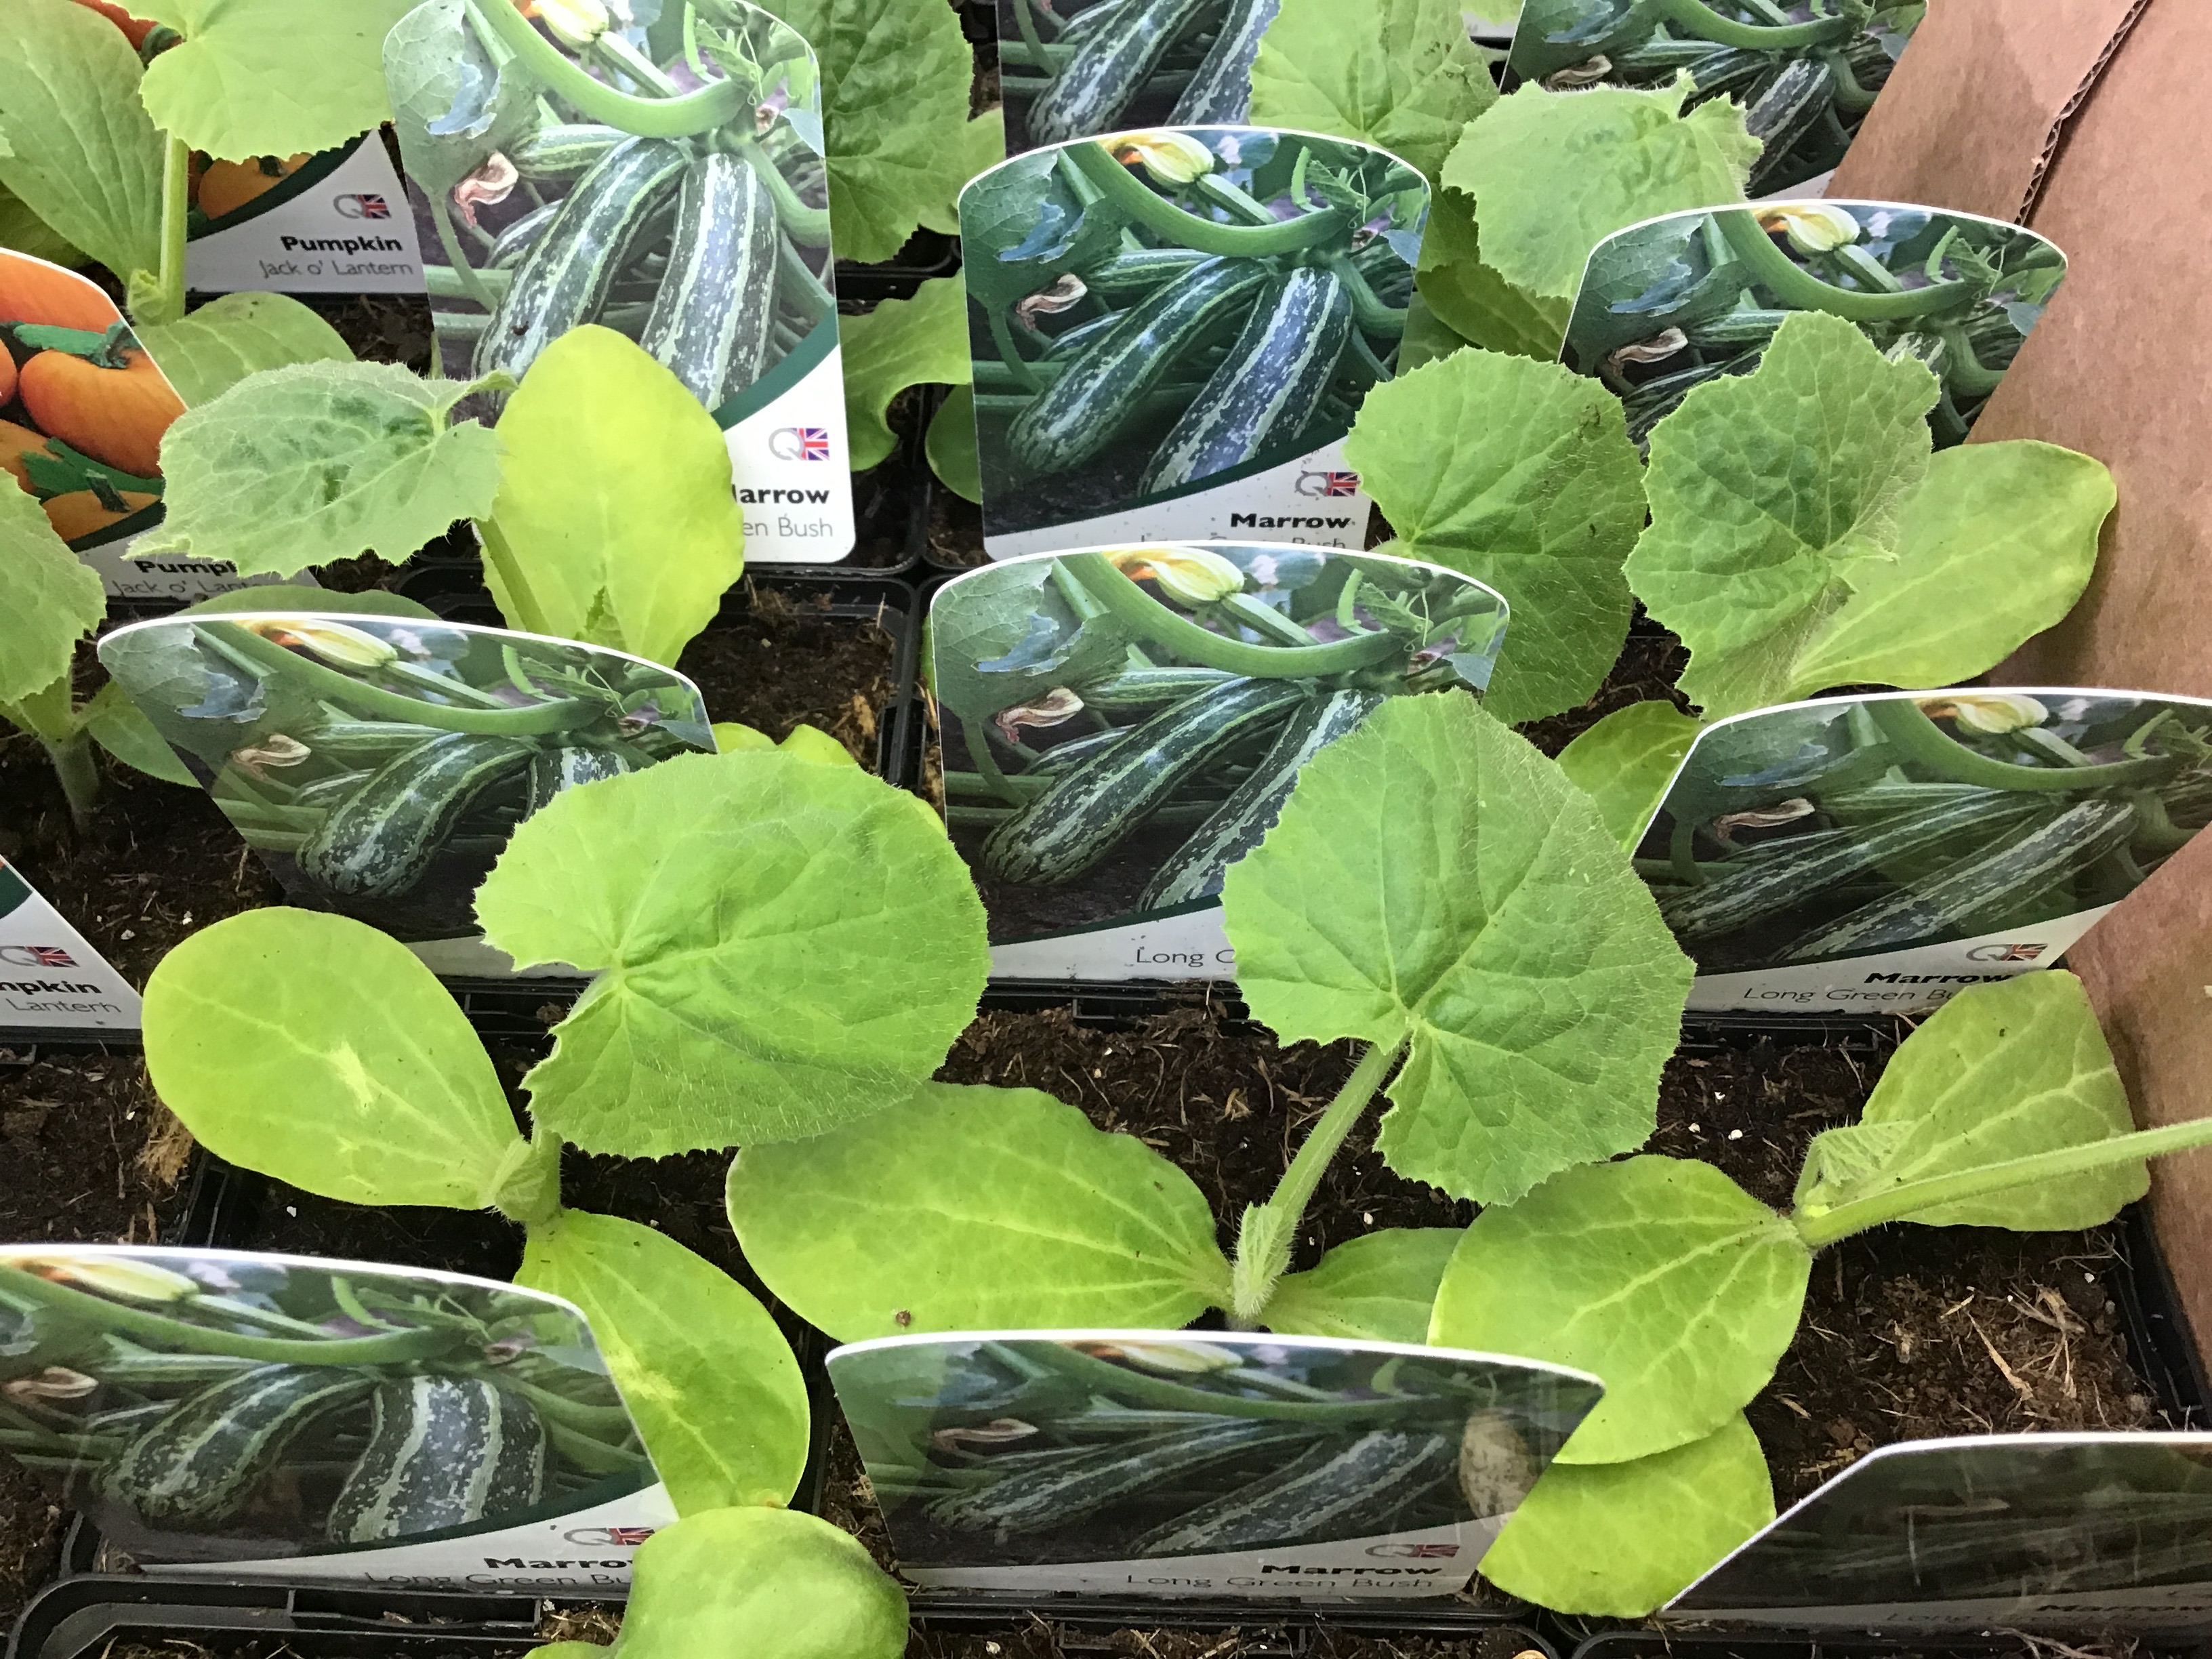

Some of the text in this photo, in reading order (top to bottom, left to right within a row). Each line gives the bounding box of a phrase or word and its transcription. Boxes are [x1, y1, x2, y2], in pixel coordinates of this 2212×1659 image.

[280, 235, 404, 255] Pumpkin
[259, 260, 301, 279] Jack
[332, 260, 414, 276] Lantern
[778, 516, 833, 537] Bush
[1230, 513, 1351, 529] Marrow
[134, 560, 237, 576] Pump
[112, 580, 164, 596] Jack
[1136, 949, 1204, 968] Long
[1864, 972, 2013, 983] Marrow
[1744, 988, 1954, 1003] Long Green Bu
[5, 998, 121, 1012] Lantern
[484, 1557, 633, 1569] Marro
[1262, 1565, 1442, 1574] Marrow
[365, 1572, 632, 1586] Long Green Bu
[1128, 1575, 1433, 1587] Long Green Bush
